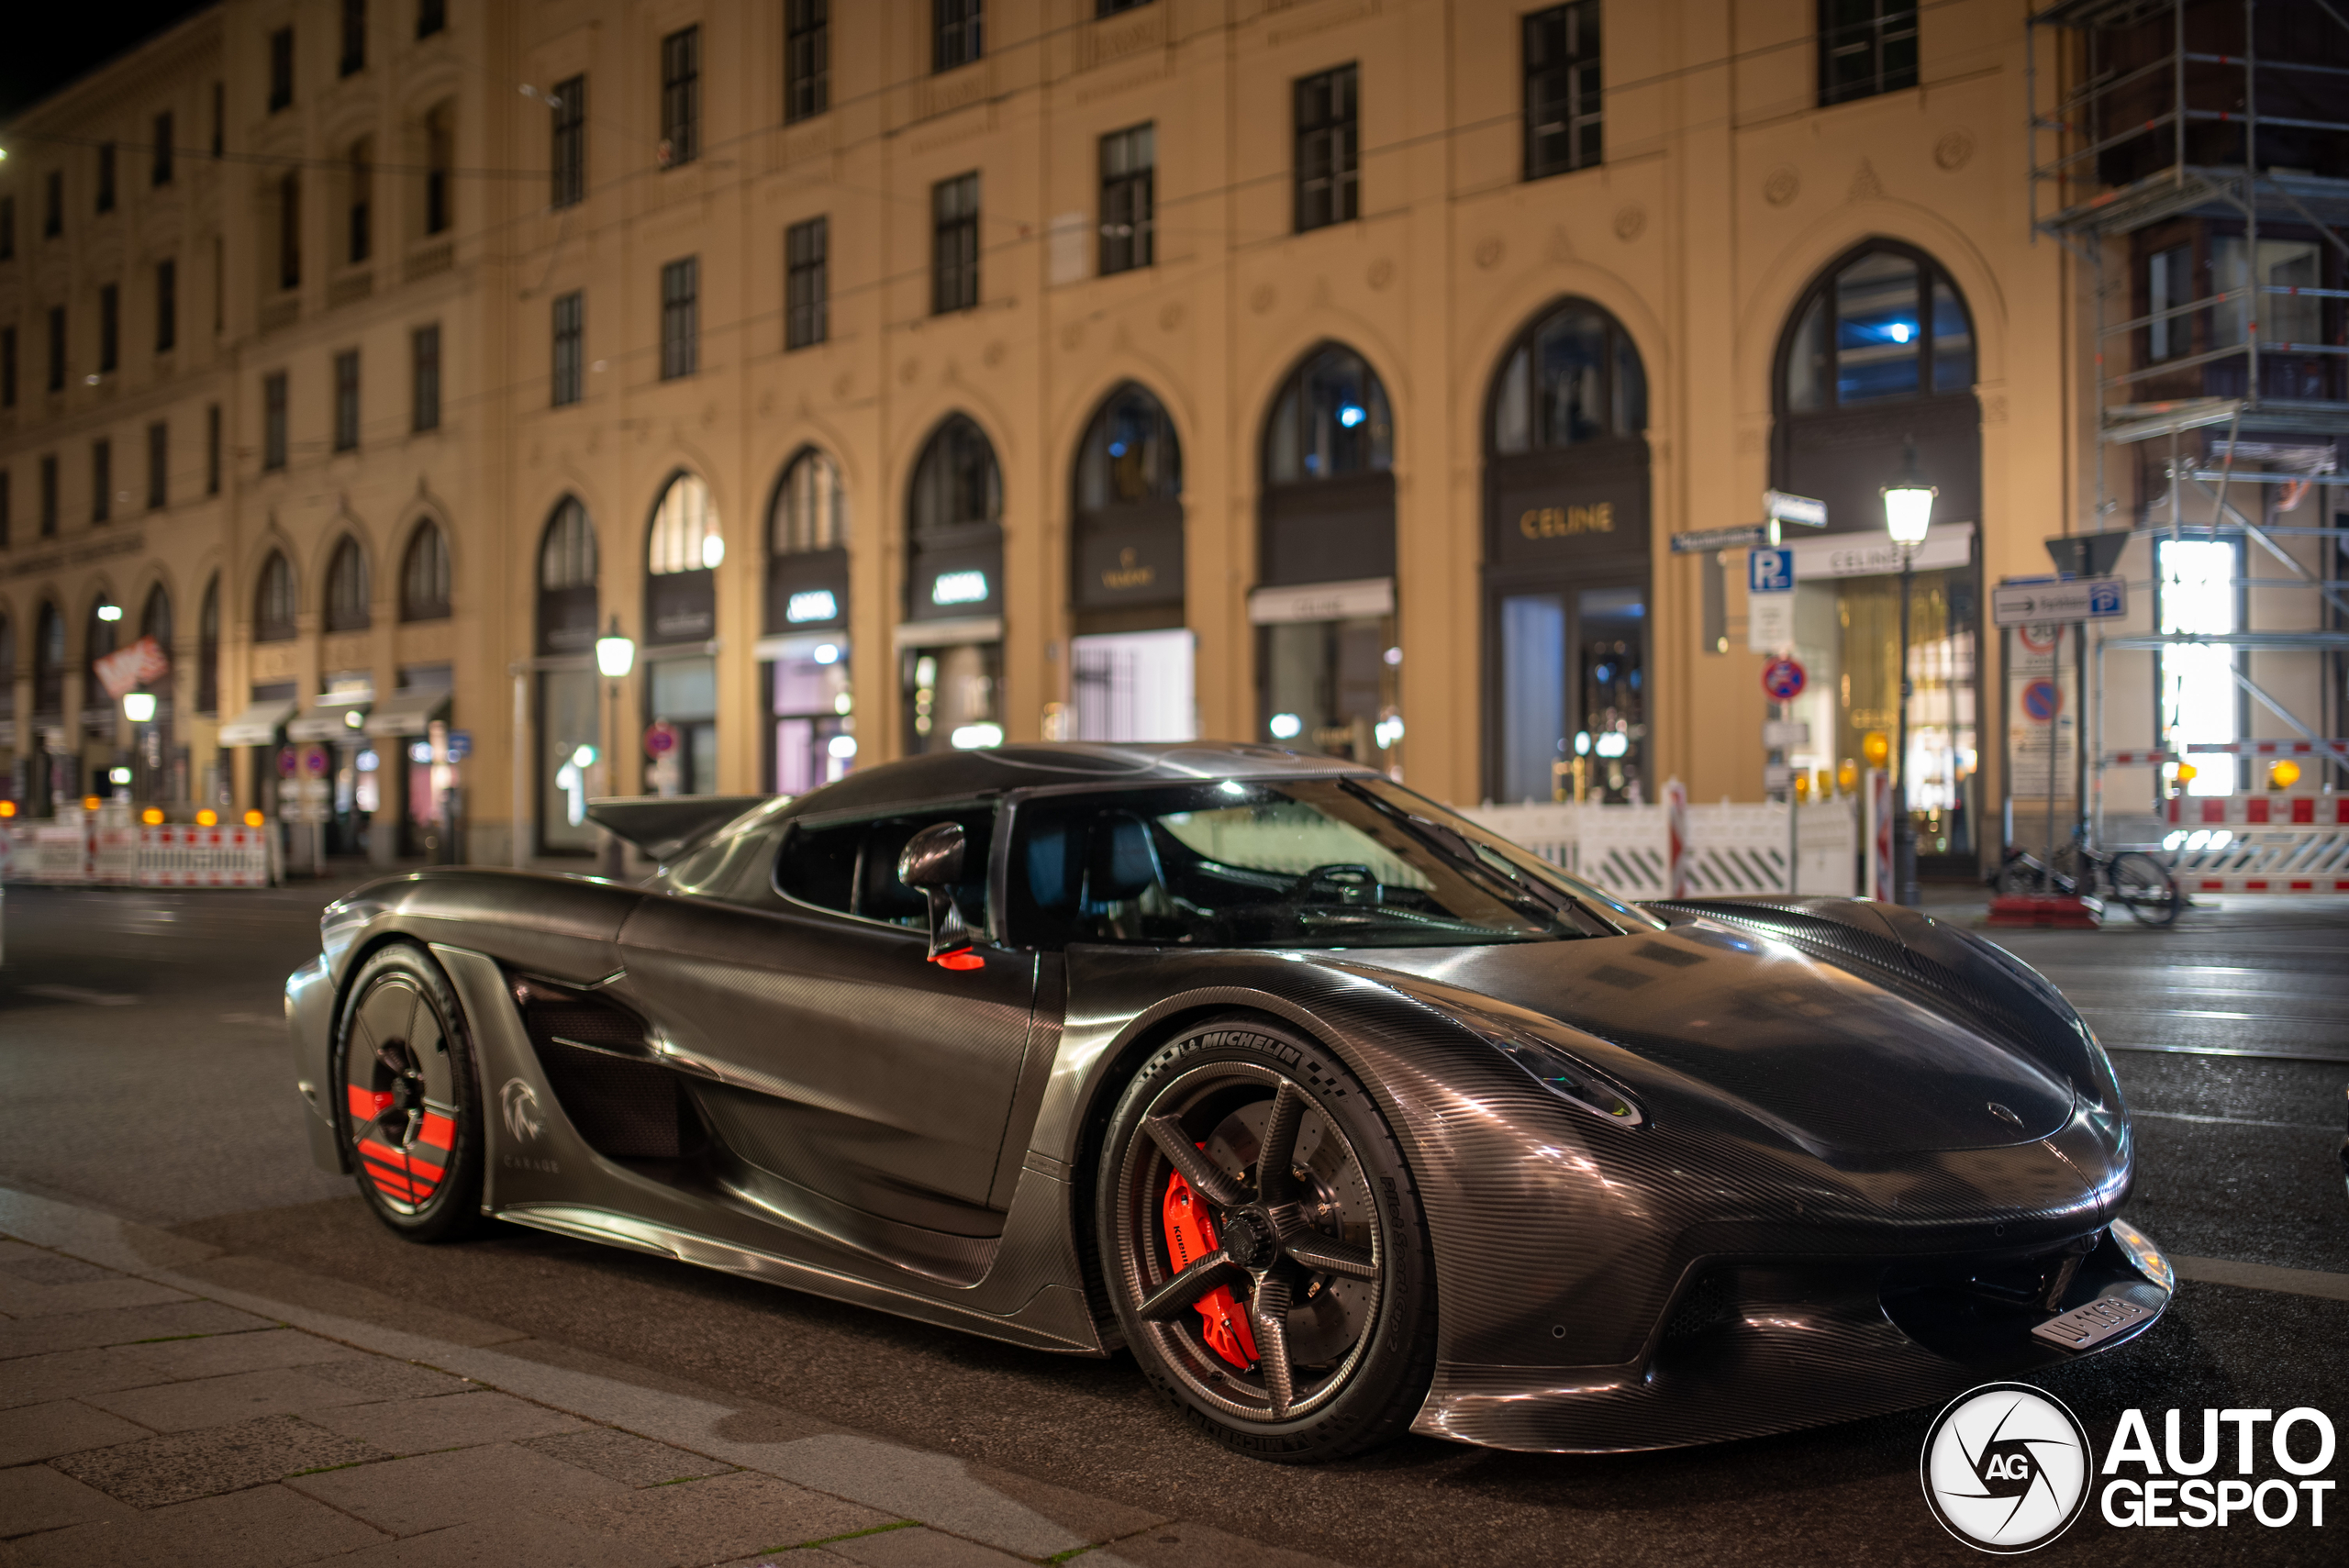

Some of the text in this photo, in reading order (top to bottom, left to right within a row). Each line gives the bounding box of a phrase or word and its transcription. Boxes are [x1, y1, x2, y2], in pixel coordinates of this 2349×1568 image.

[1520, 502, 1615, 539] CELINE
[1201, 1031, 1303, 1065] MICHELIN
[1379, 1176, 1405, 1228] Pilot
[1392, 1230, 1408, 1295] Sport
[1389, 1296, 1408, 1335] Cup
[1385, 1337, 1399, 1353] 2
[1188, 1413, 1285, 1451] MICHELIN
